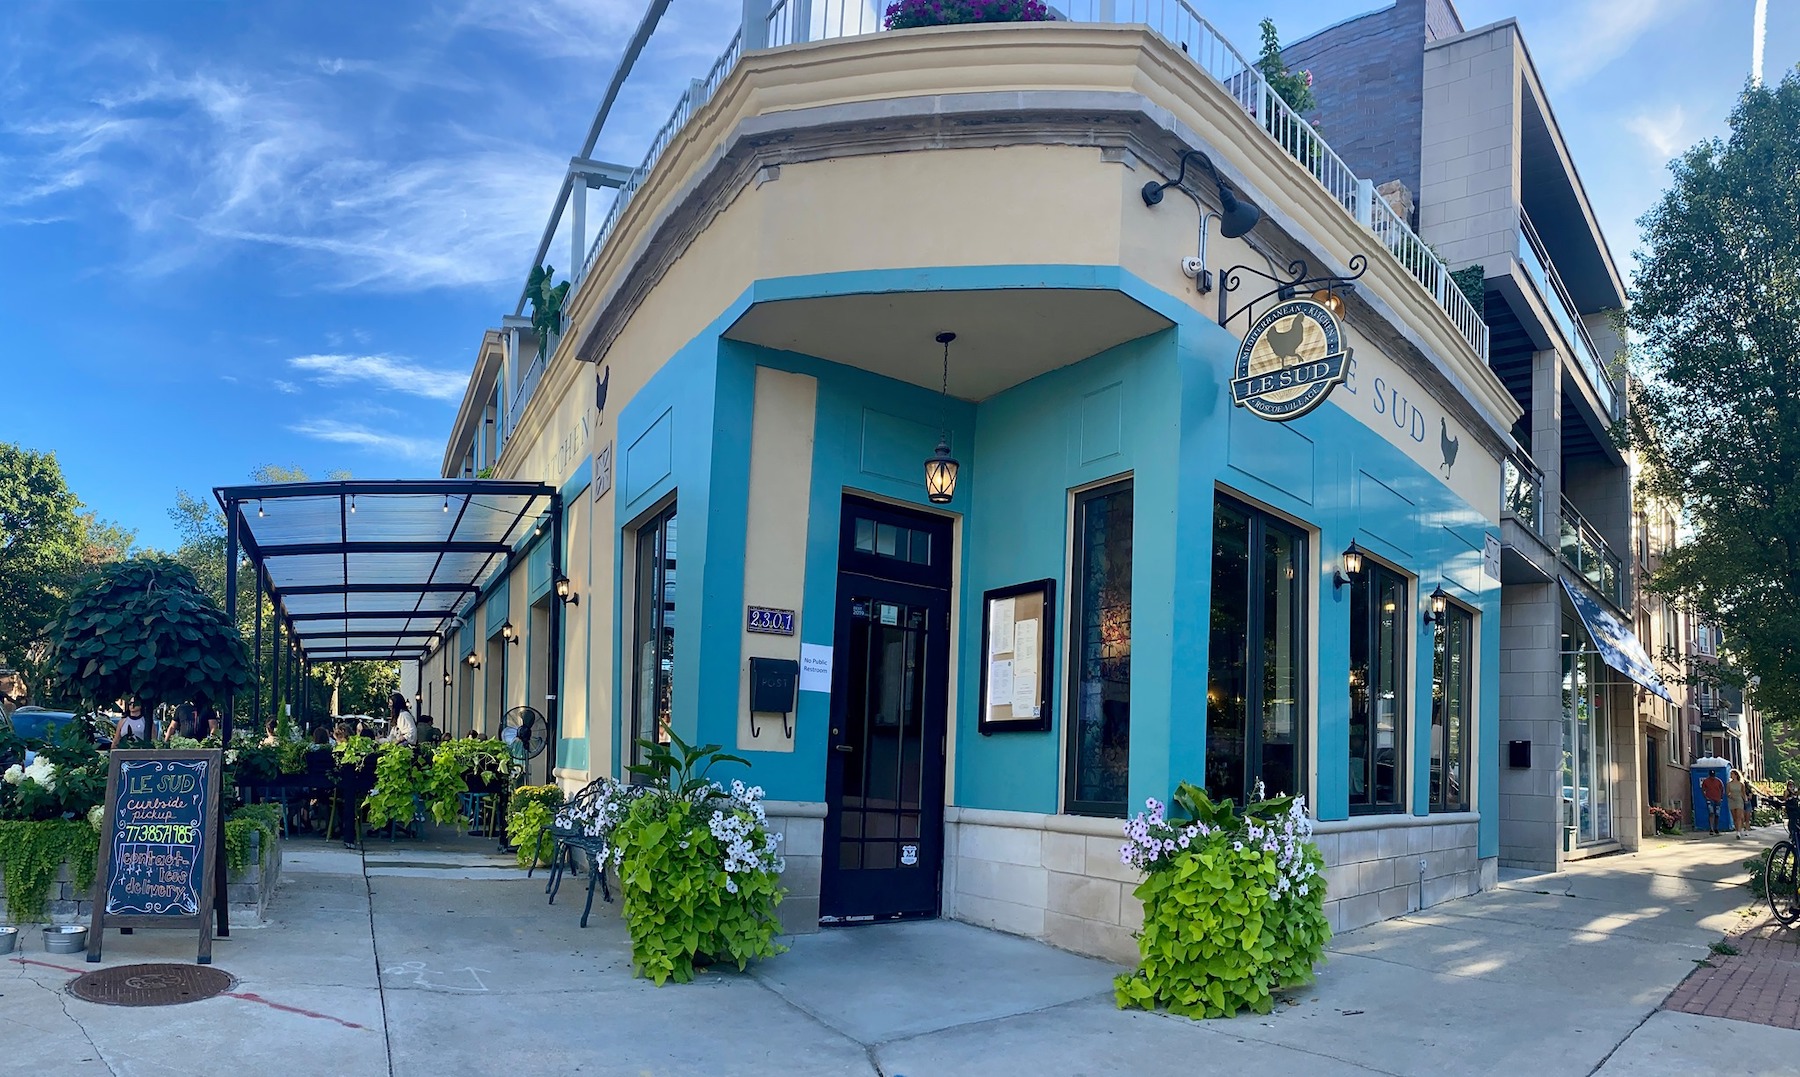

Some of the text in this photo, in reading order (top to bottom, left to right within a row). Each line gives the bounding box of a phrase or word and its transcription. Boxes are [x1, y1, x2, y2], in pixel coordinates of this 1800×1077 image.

[1242, 305, 1335, 360] MEDITERRANEAN KITCHEN
[1246, 362, 1330, 397] LE SUD
[1254, 387, 1319, 413] ROSCOE VILLAGE
[1373, 377, 1425, 443] SUD
[750, 611, 792, 630] 2301
[803, 666, 828, 674] Restroom
[812, 658, 828, 666] Public
[130, 774, 195, 794] LE SUD
[127, 796, 187, 811] curbside
[132, 810, 177, 823] pickup
[158, 867, 187, 884] less
[125, 877, 186, 902] delivery
